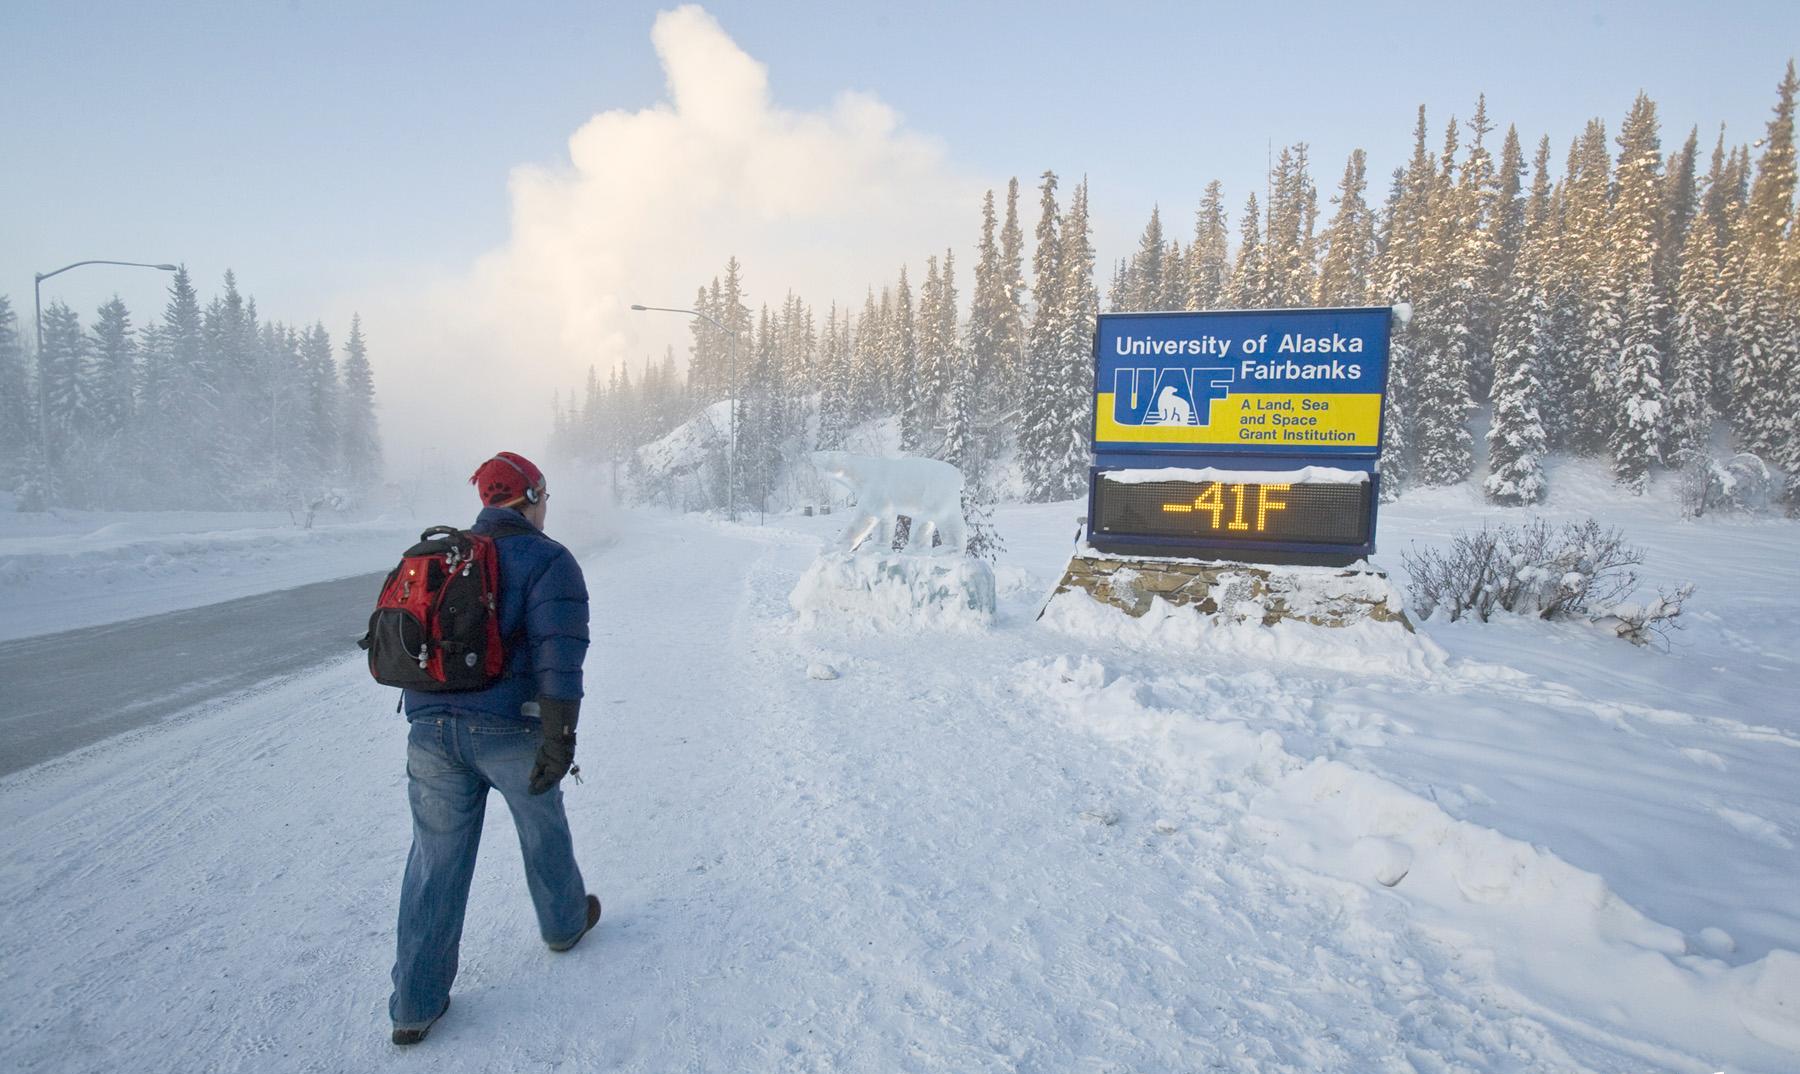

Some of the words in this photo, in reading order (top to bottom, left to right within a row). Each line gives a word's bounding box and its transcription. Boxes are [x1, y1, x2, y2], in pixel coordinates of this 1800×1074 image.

[1116, 335, 1232, 358] University
[1242, 334, 1268, 354] of
[1278, 333, 1363, 353] Alaska
[1240, 360, 1361, 380] Fairbanks
[1113, 368, 1235, 427] UAF
[1241, 399, 1251, 410] A
[1257, 399, 1295, 412] Land,
[1301, 399, 1329, 411] Sea
[1240, 414, 1266, 425] and
[1272, 414, 1317, 428] Space
[1239, 428, 1277, 440] Grant
[1283, 429, 1356, 441] Institution
